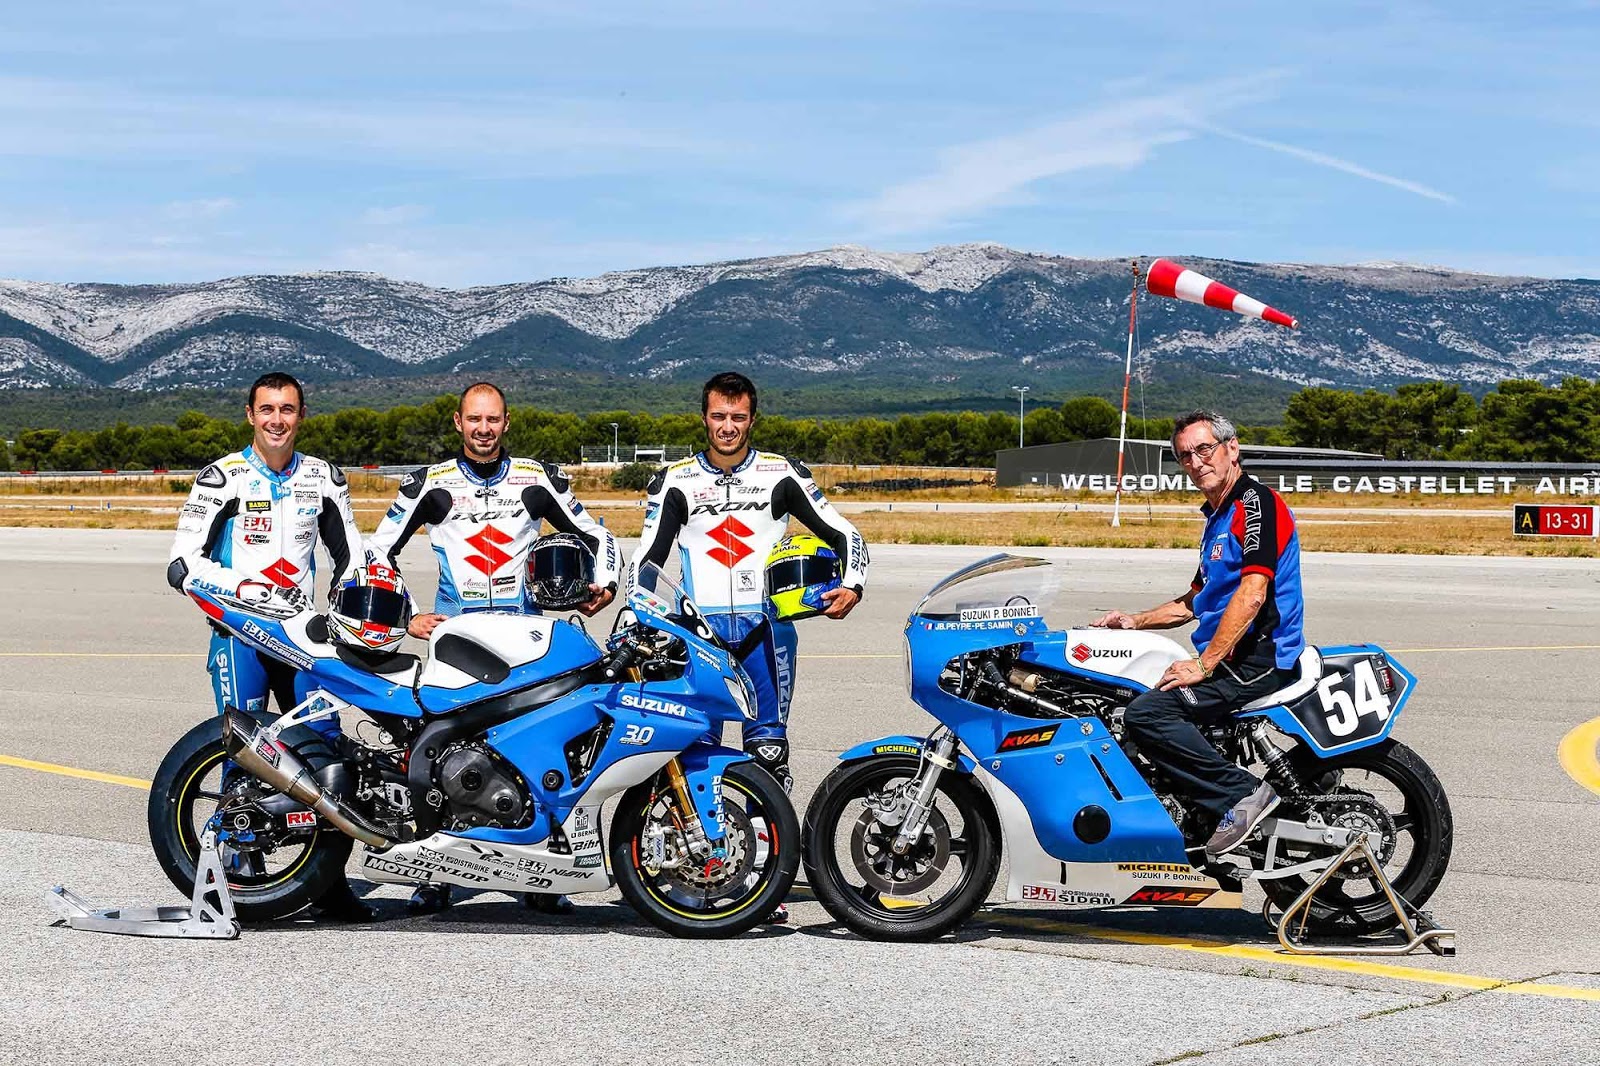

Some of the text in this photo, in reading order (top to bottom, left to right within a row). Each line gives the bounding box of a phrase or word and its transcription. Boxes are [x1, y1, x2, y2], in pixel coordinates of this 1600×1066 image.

[1279, 475, 1313, 491] LE
[1333, 476, 1516, 493] CASTELLET
[1522, 513, 1533, 528] A
[1546, 513, 1587, 529] 13-31
[606, 531, 615, 572] SUZUKI
[772, 545, 800, 556] SHARK
[851, 531, 861, 572] SUZUKI
[190, 579, 236, 597] SUZUK
[962, 607, 1037, 620] SUZUKI P. BONNET
[988, 621, 1013, 629] SAMIN
[267, 642, 314, 671] YOSHIMURA
[621, 695, 687, 717] SUZUKI
[1317, 660, 1391, 737] 54
[626, 724, 655, 744] 30
[1002, 731, 1054, 748] KVAS
[876, 745, 918, 754] MICHELIN
[711, 776, 726, 833] DUNLOP
[287, 812, 315, 824] RK
[571, 839, 600, 851] Bihr
[418, 847, 443, 861] NGK
[366, 858, 430, 880] MOTUL
[409, 859, 490, 882] DUNLOP
[454, 859, 490, 874] DISTRIBIKE
[548, 868, 594, 879] NISSIN
[1118, 864, 1190, 873] MICHELIN
[1172, 873, 1207, 882] BONNET
[1058, 894, 1115, 905] SIDAM
[1132, 891, 1209, 902] KVAS
